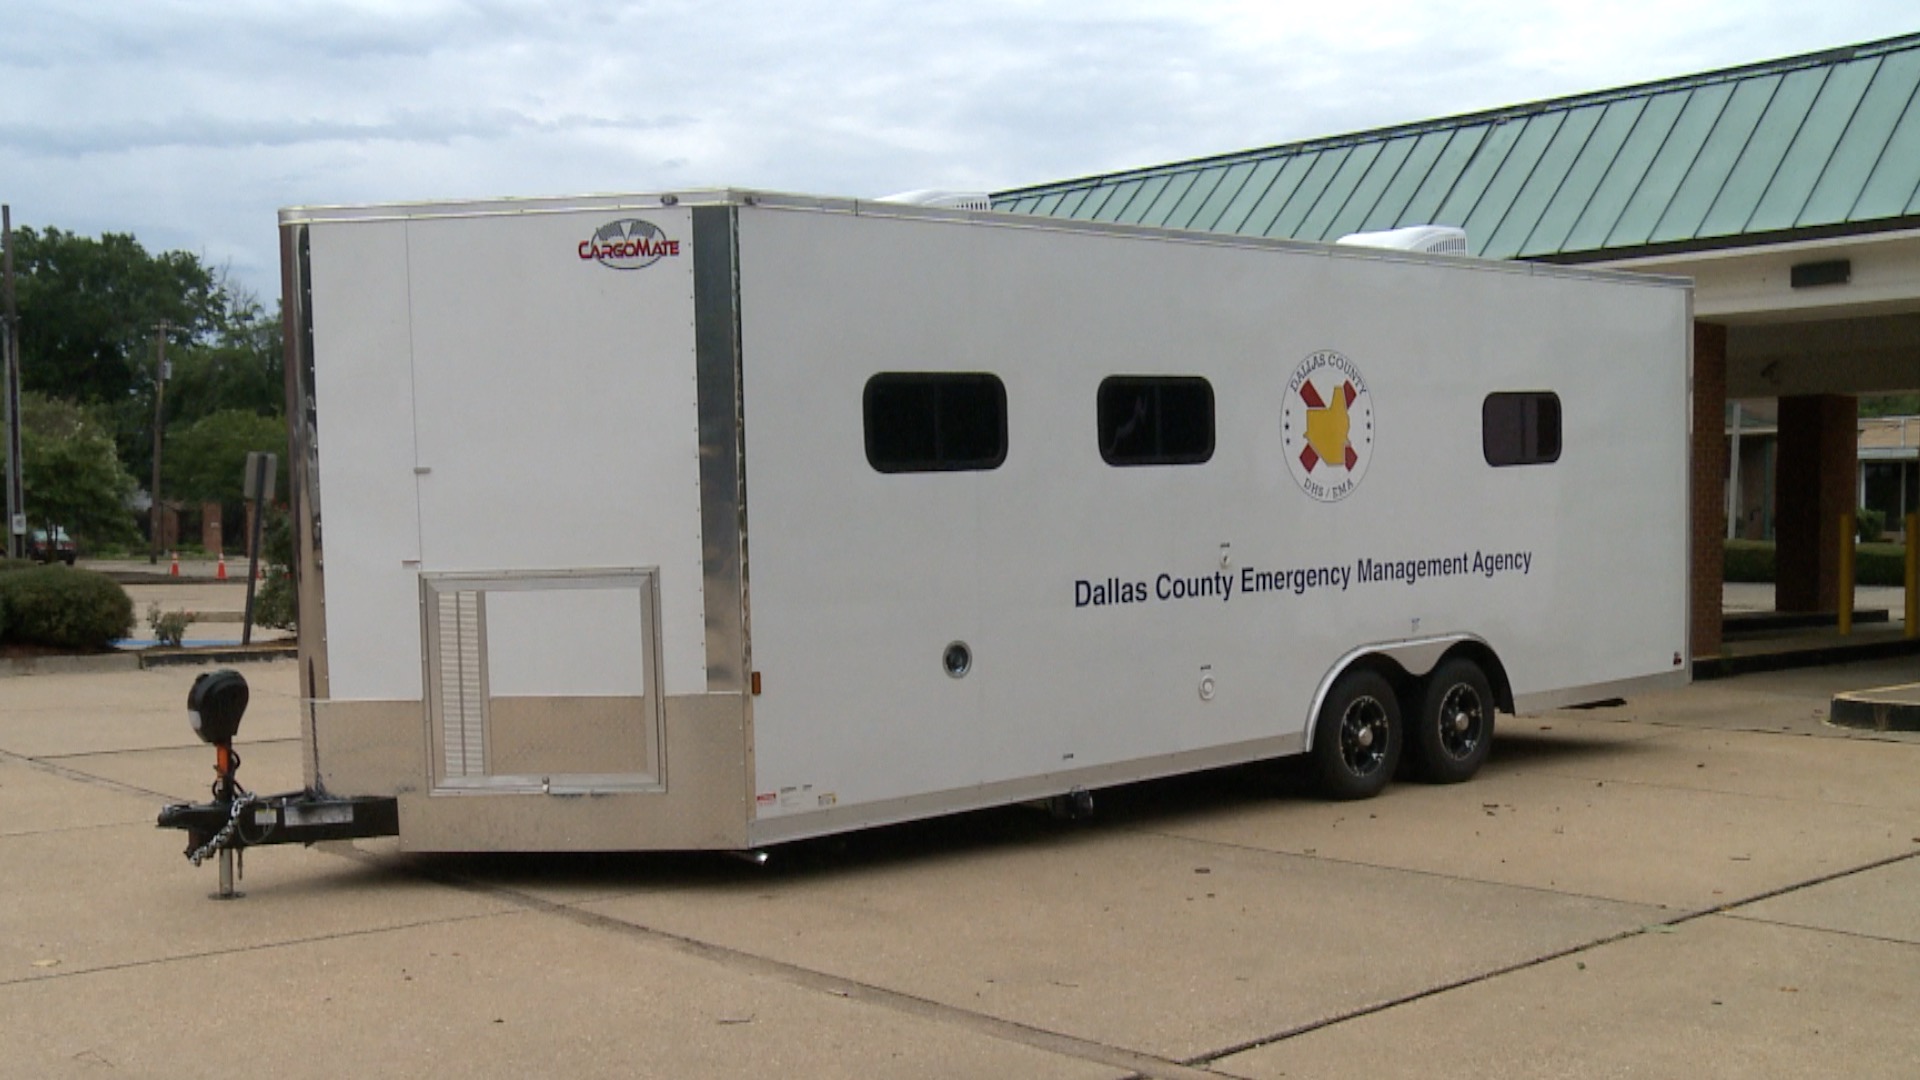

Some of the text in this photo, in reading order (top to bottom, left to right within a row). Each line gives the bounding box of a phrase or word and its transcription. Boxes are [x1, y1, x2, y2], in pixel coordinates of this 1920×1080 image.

[1290, 353, 1367, 394] DALLAS COUNTY
[1304, 477, 1324, 497] DHS
[1332, 478, 1354, 499] EMA
[1074, 550, 1533, 608] Dallas County Emergency Management Agency
